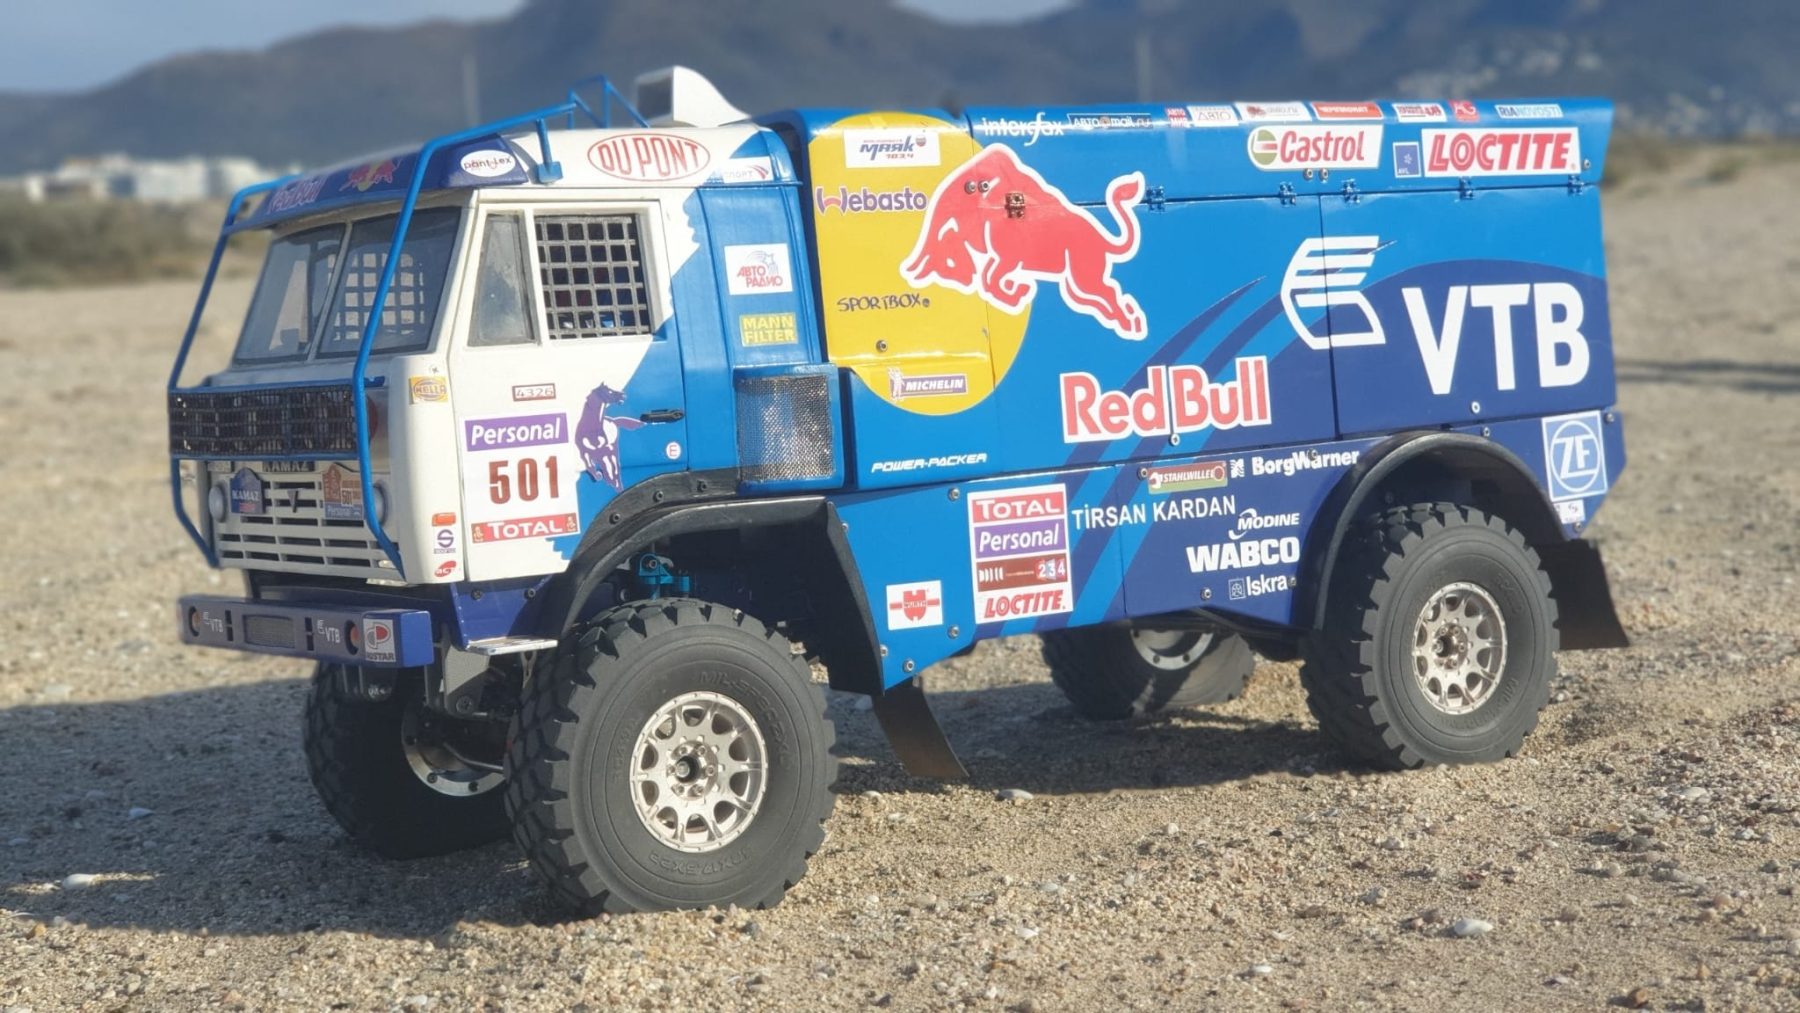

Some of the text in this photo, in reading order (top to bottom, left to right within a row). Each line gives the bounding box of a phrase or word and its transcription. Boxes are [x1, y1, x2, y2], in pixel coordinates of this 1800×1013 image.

[981, 112, 1065, 147] interfax
[1280, 130, 1365, 163] Castrol
[1428, 132, 1573, 171] LOCTITE
[816, 187, 927, 213] Webasto
[737, 265, 766, 277] АВТО
[742, 314, 793, 329] MANN
[745, 329, 797, 344] FILTER
[1401, 282, 1591, 394] VTB
[515, 387, 554, 397] 4326
[905, 379, 964, 391] MICHELIN
[1062, 358, 1270, 438] Red Bull
[471, 417, 560, 446] Personal
[871, 453, 987, 473] POWER-PACKER
[1251, 450, 1360, 477] BorgWarner
[1552, 434, 1598, 480] ZF
[488, 455, 560, 505] 501
[976, 498, 1062, 520] TOTAL
[1152, 495, 1236, 522] KARDAN
[1237, 512, 1300, 530] MODINE
[487, 520, 563, 540] TOTAL
[979, 523, 1059, 553] Personal
[1186, 536, 1300, 573] WABCO
[1246, 574, 1289, 596] Iskra
[984, 590, 1064, 619] LOCTITE
[325, 627, 341, 643] VTB
